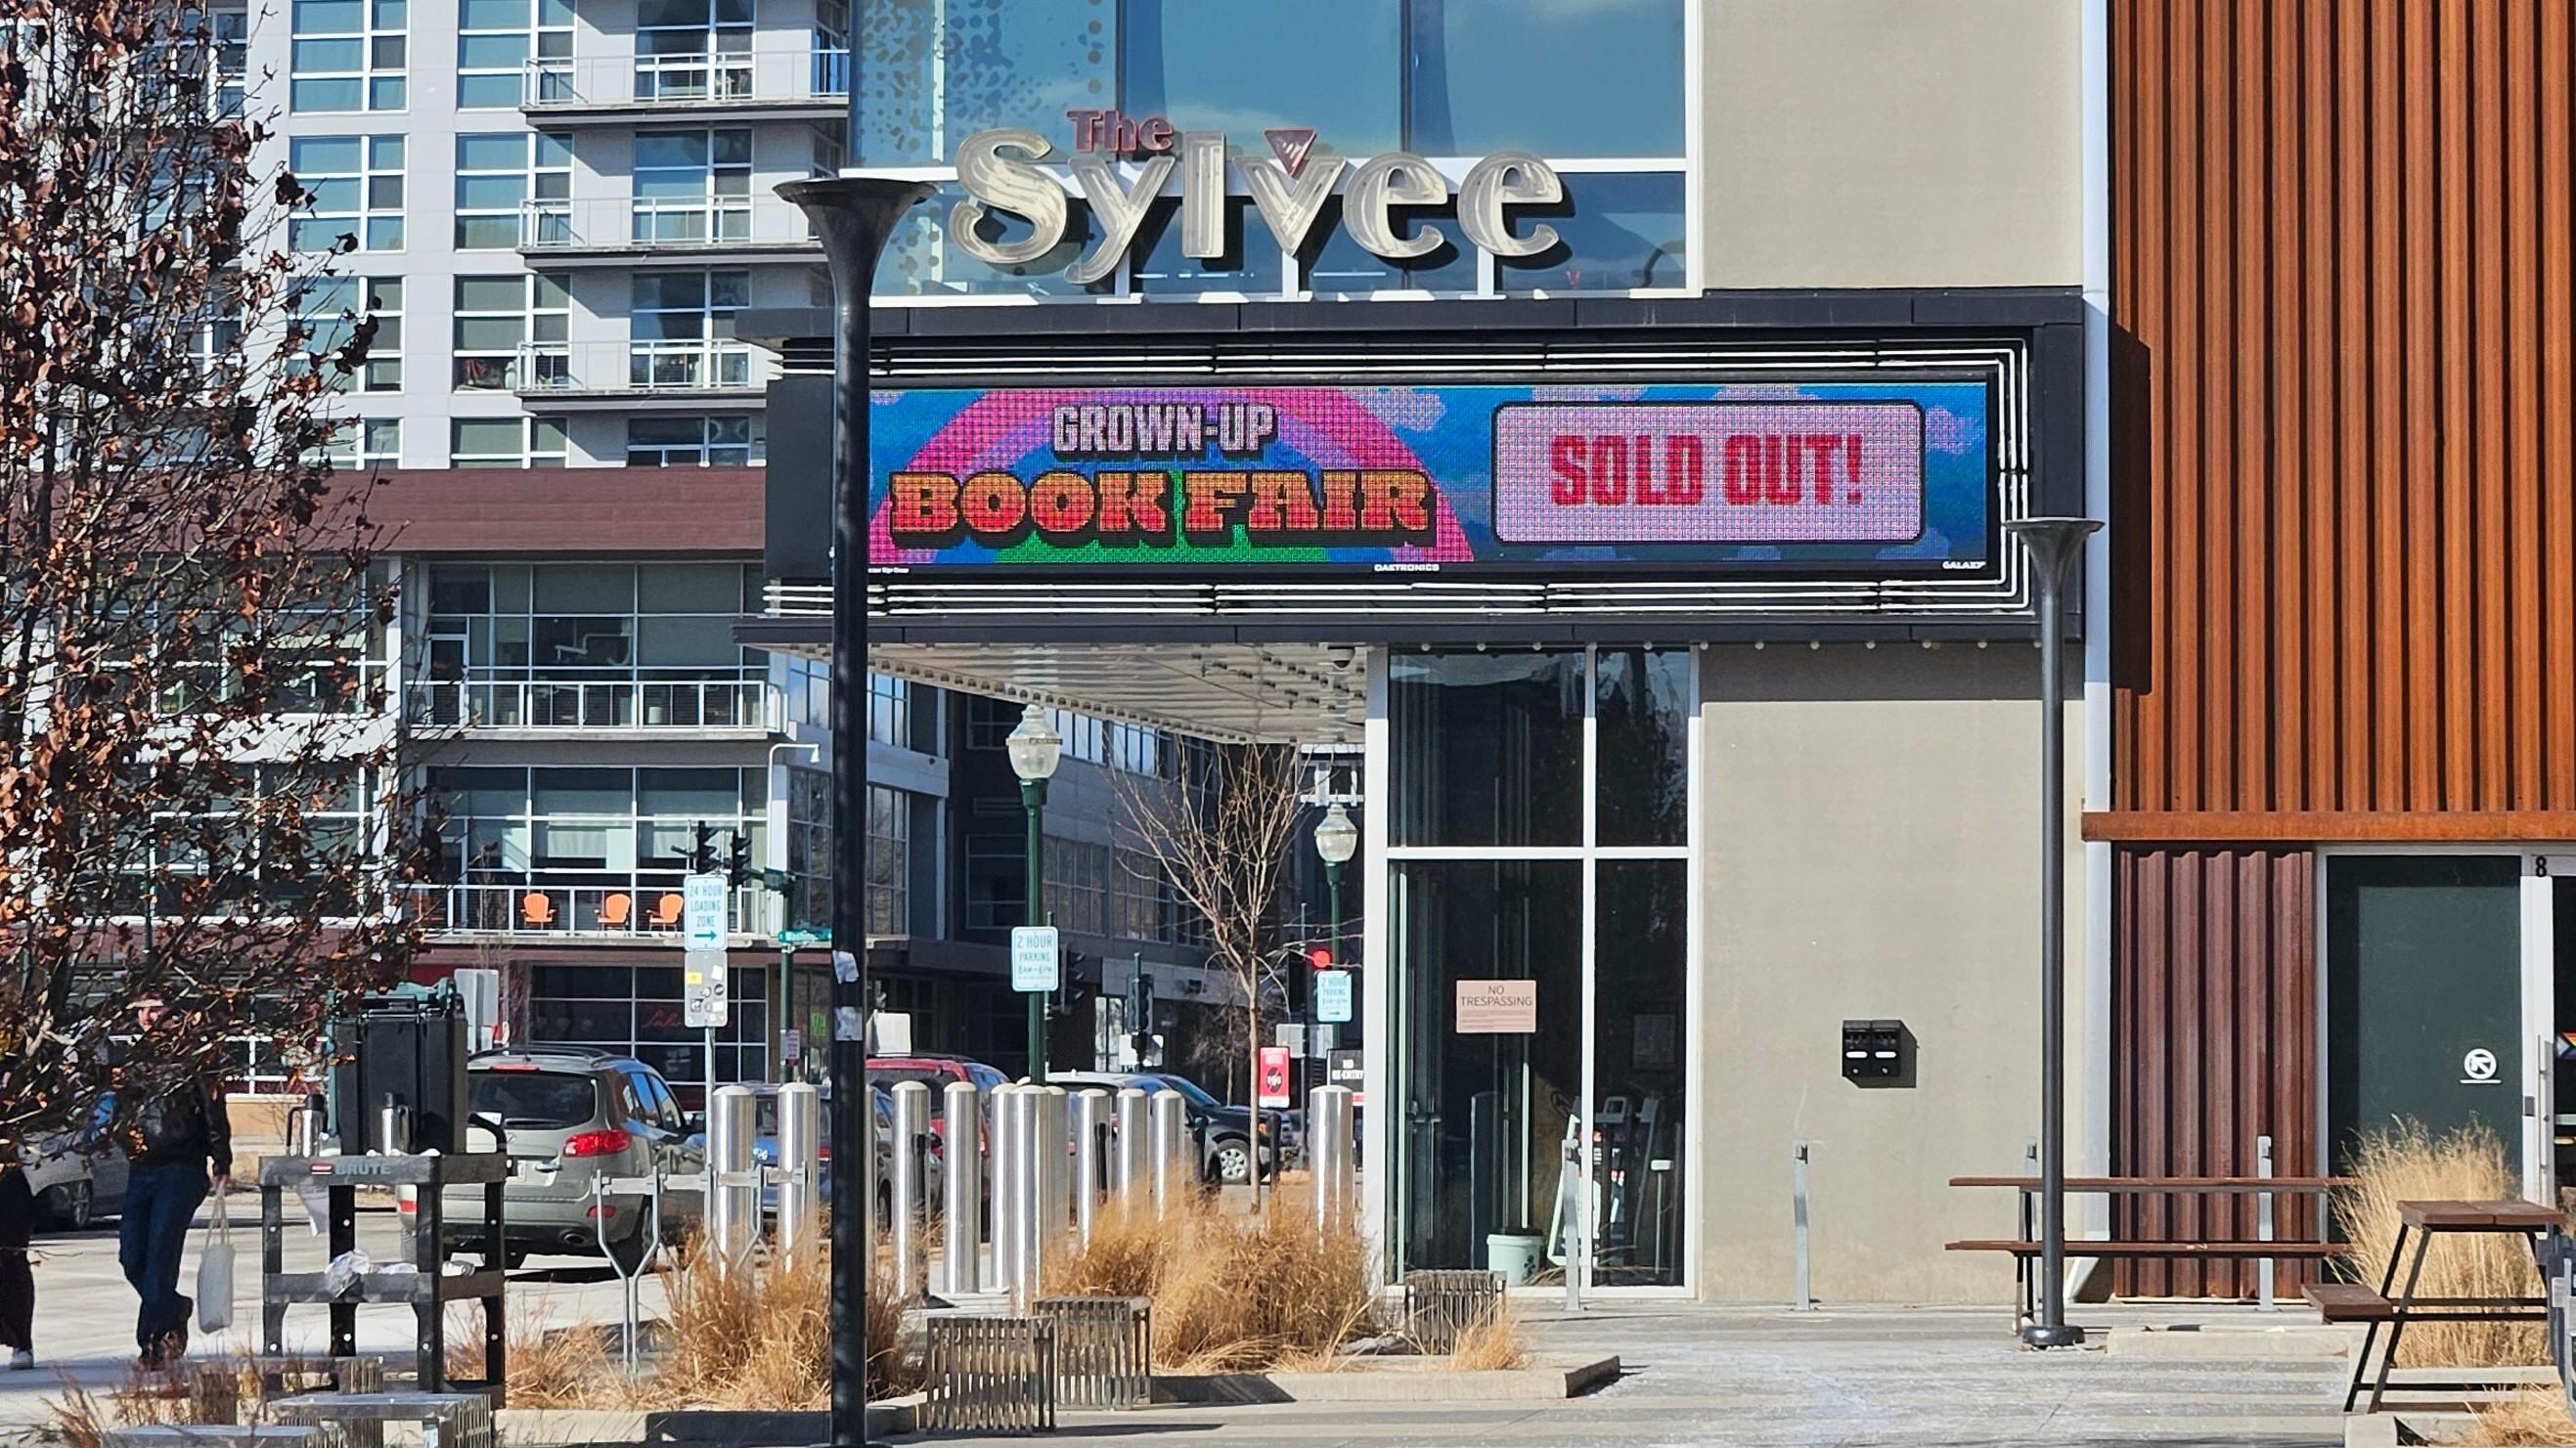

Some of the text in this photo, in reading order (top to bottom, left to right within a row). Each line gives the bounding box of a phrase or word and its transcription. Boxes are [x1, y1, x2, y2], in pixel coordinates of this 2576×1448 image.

[1066, 110, 1174, 152] The
[948, 126, 1564, 285] Sylvee
[1052, 403, 1277, 456] GROWN-UP
[1550, 433, 1865, 506] SOLD OUT!
[891, 471, 1432, 540] BOOK FAIR
[2535, 855, 2548, 878] 8
[688, 884, 724, 898] 24 HOUR
[689, 900, 722, 912] LOADING
[696, 914, 716, 928] ZONE
[1016, 934, 1053, 948] 2 HOUR
[1018, 951, 1051, 963] PARKING
[1488, 985, 1505, 995] NO
[1460, 995, 1533, 1007] TRESPASSING
[334, 1162, 392, 1175] BRUTE
